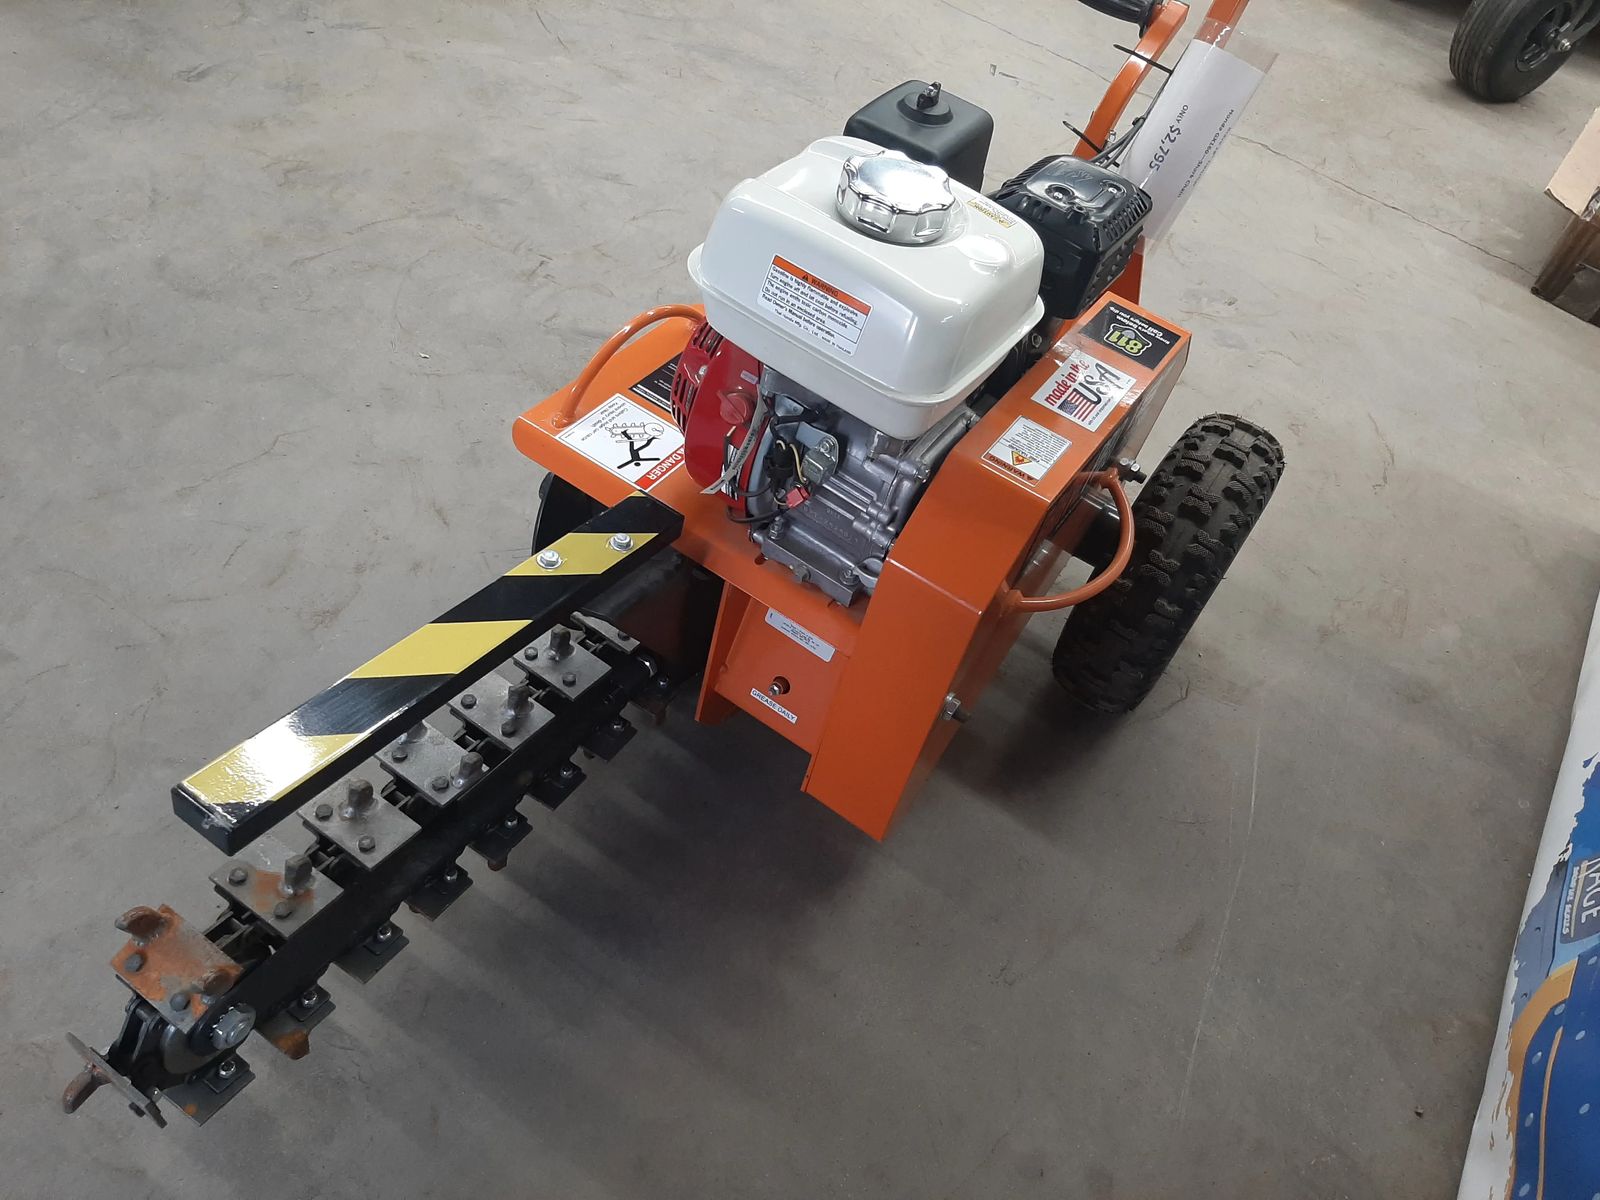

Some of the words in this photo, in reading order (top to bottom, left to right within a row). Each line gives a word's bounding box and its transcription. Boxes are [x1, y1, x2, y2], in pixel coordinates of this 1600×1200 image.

[1175, 104, 1189, 125] ONLY
[1149, 124, 1182, 171] $2,795
[811, 279, 839, 297] WARNING
[1109, 330, 1143, 353] 811
[1148, 327, 1163, 337] Call
[1044, 379, 1070, 407] made
[1060, 371, 1076, 383] in
[1069, 359, 1089, 373] the
[1070, 362, 1125, 404] USA
[646, 453, 681, 480] DANGER
[989, 456, 1025, 477] WARNING
[752, 690, 776, 709] GREASE
[778, 707, 795, 721] DAILY
